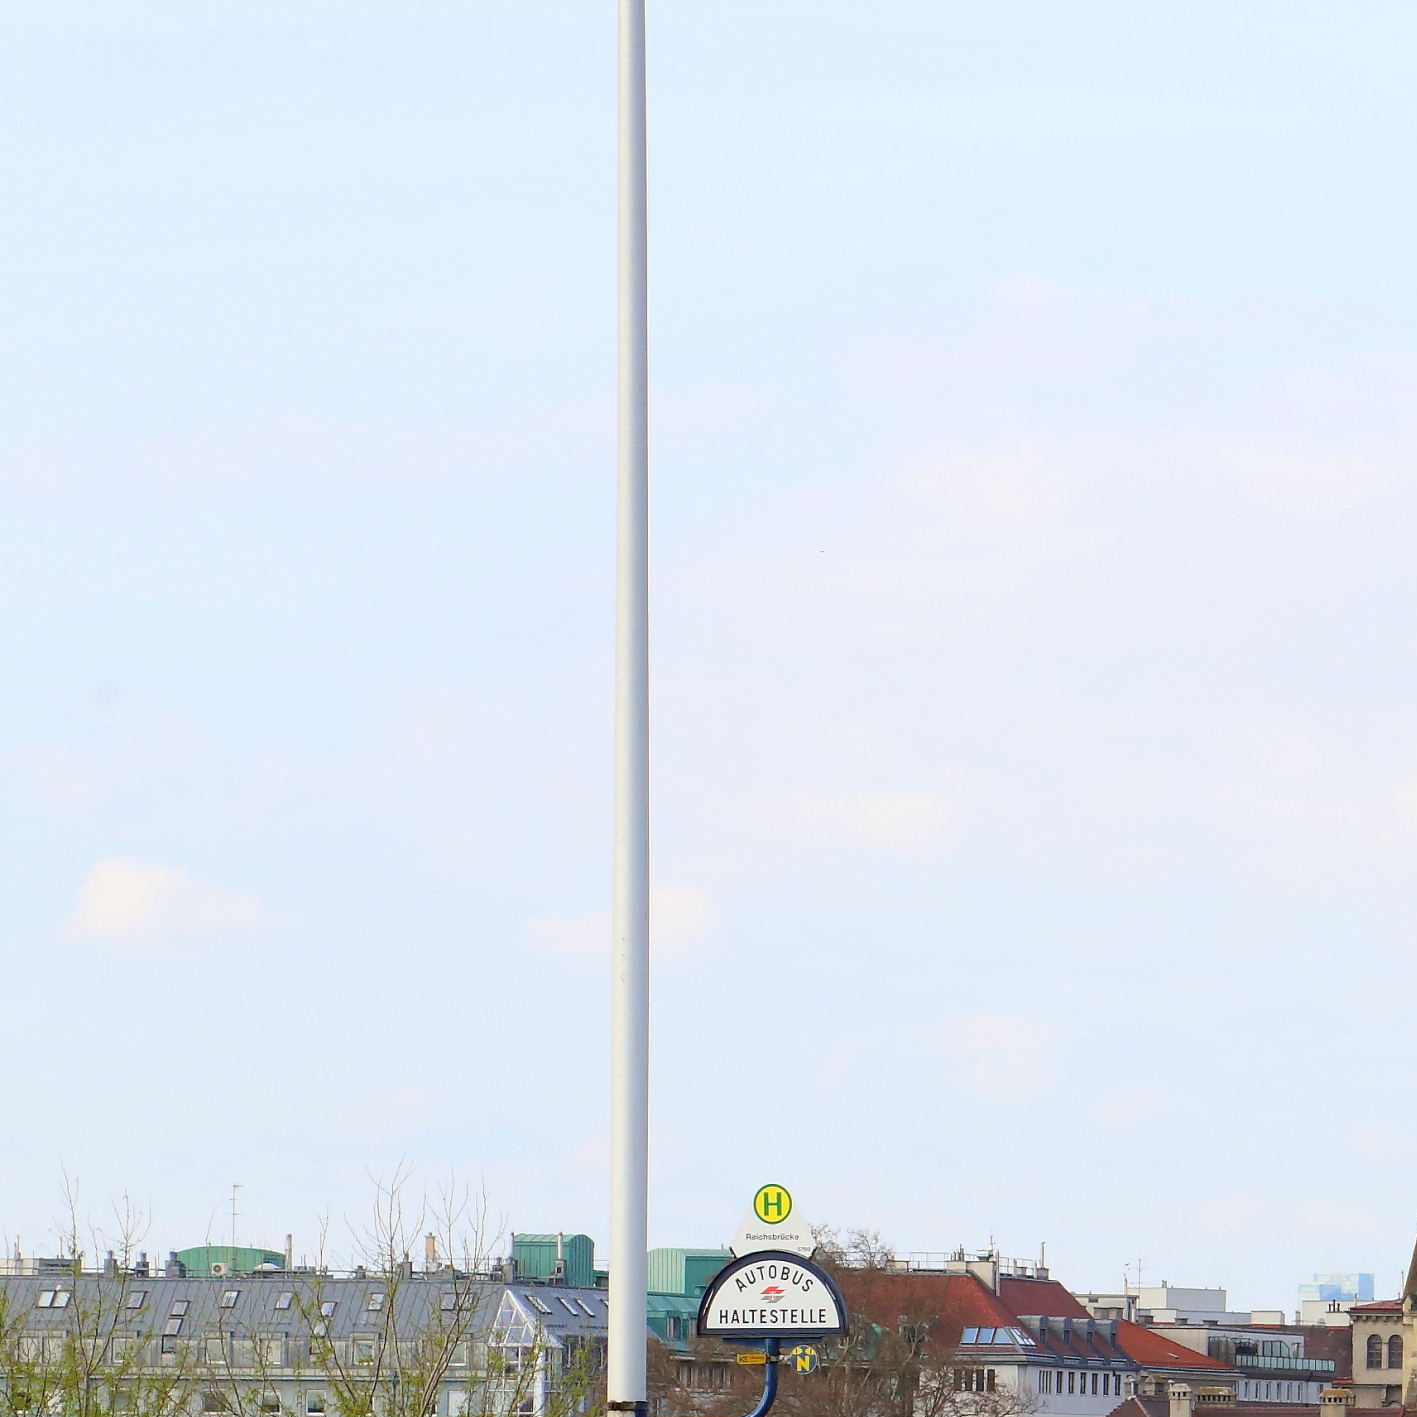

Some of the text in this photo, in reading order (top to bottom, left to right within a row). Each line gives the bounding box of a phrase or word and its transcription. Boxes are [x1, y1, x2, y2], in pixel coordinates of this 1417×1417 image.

[763, 1191, 782, 1217] H
[745, 1233, 800, 1241] Reichsbrücke
[734, 1264, 814, 1293] AUTOBUS
[718, 1308, 827, 1325] HALTESTELLE
[795, 1355, 811, 1372] N
